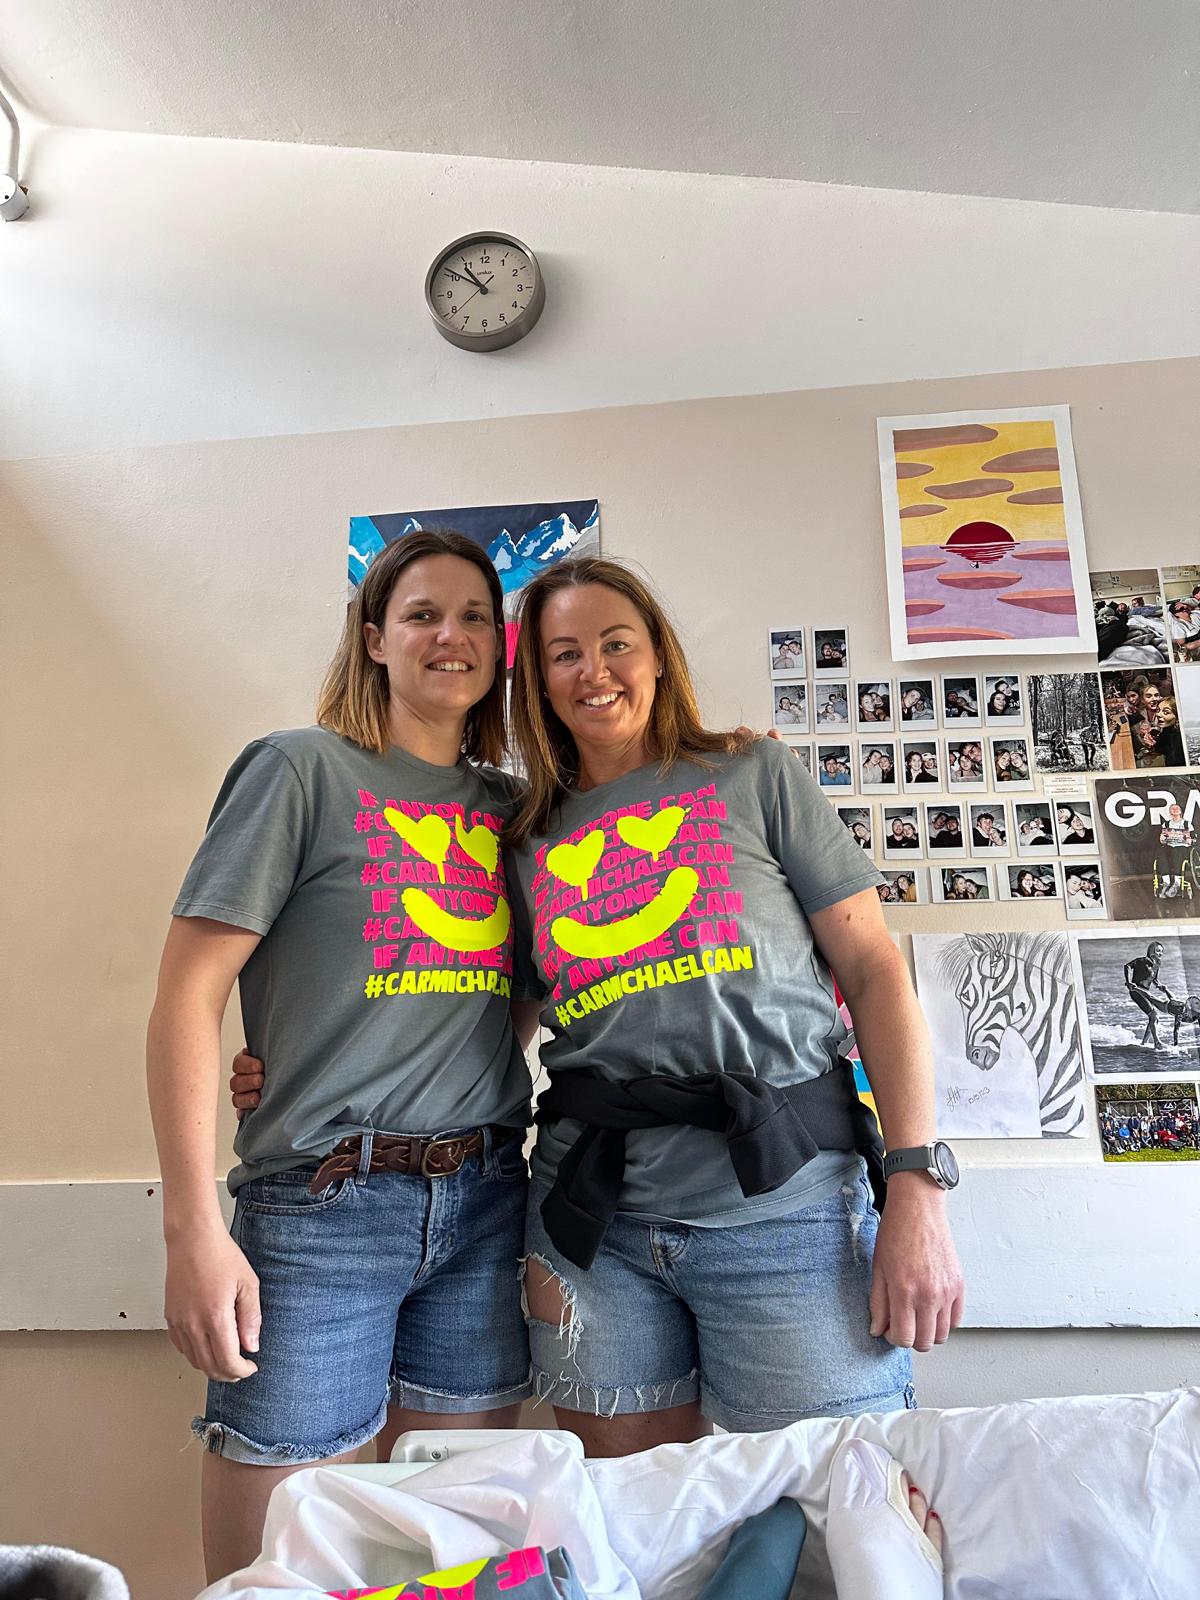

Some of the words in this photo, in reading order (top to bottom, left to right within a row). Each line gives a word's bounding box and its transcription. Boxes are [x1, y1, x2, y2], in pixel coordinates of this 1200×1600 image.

[480, 256, 490, 264] 12
[512, 269, 518, 277] 2
[450, 274, 460, 282] 10
[517, 284, 523, 292] 3
[446, 290, 453, 299] 9
[451, 305, 457, 314] 8
[511, 301, 517, 309] 4
[463, 316, 470, 325] 7
[499, 313, 505, 322] 5
[481, 319, 488, 328] 6
[660, 783, 716, 810] CAN
[670, 823, 722, 845] AN
[367, 835, 392, 857] IF
[372, 888, 397, 912] IF
[418, 887, 495, 915] NYONE
[569, 879, 660, 924] NYONE
[373, 944, 399, 969] IF
[405, 943, 503, 967] ANYONE
[568, 931, 675, 990] ANYONE
[678, 918, 739, 948] CAN
[554, 945, 753, 1027] #CARMCHAELCAN
[495, 1546, 545, 1591] IF
